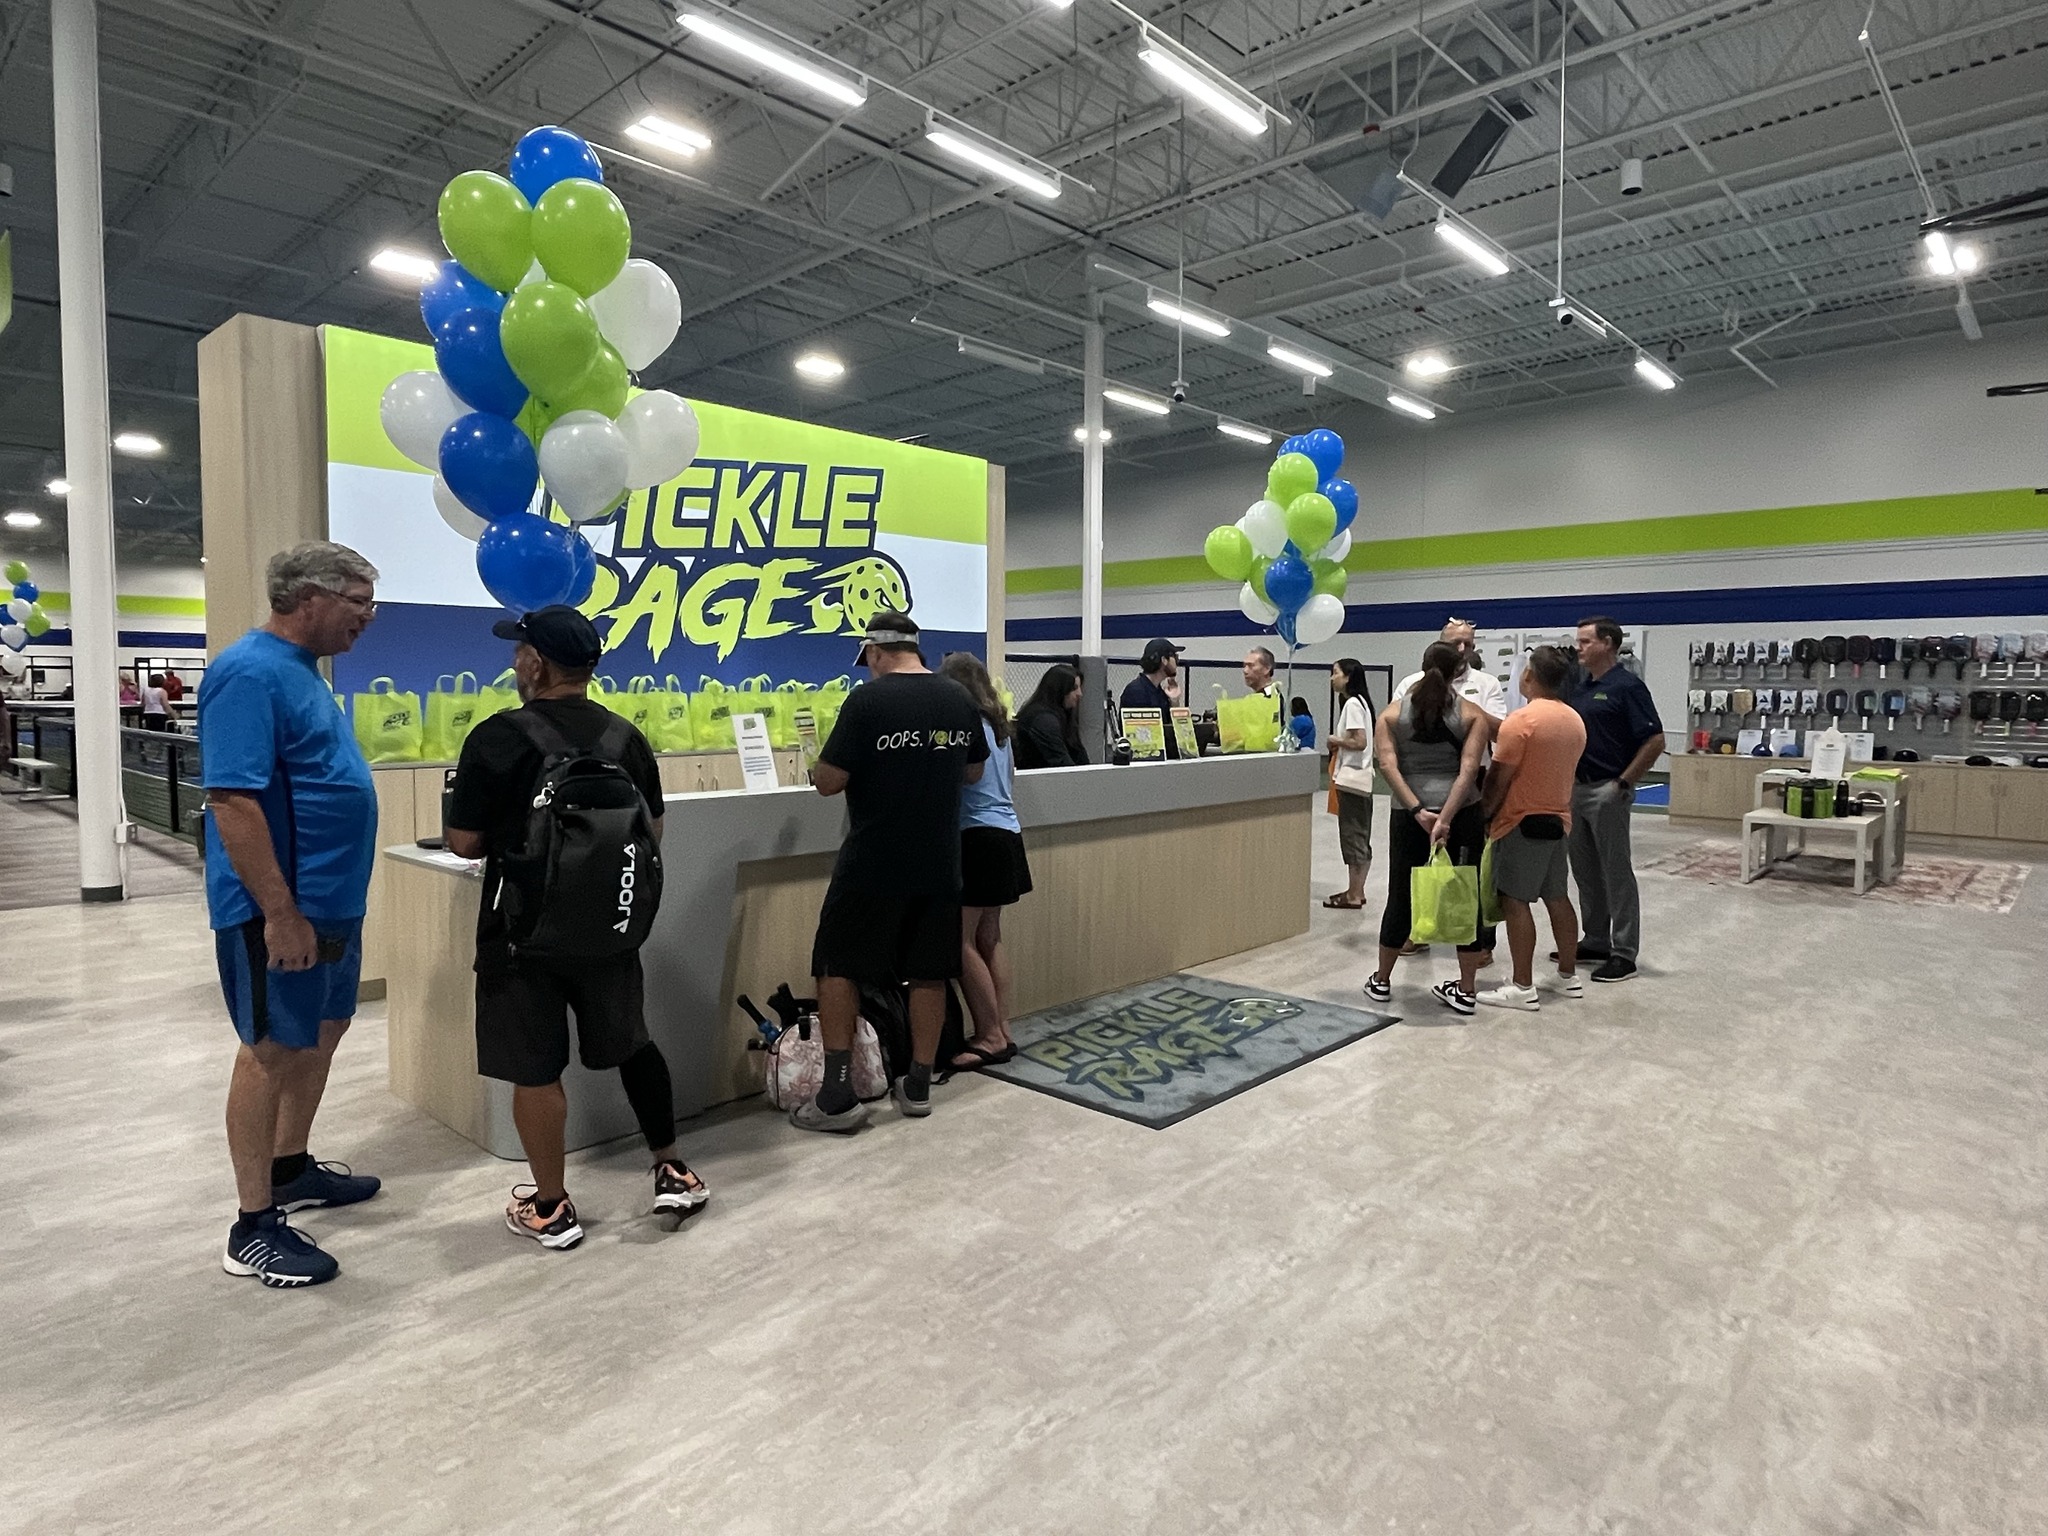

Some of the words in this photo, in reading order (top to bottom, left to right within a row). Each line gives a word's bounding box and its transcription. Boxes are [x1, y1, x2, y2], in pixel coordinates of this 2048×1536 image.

[547, 461, 882, 550] ICKLE
[876, 730, 923, 751] OOPS.
[617, 842, 637, 918] JOOLA
[1022, 986, 1221, 1073] PICKLE
[1067, 1008, 1244, 1101] RAGE
